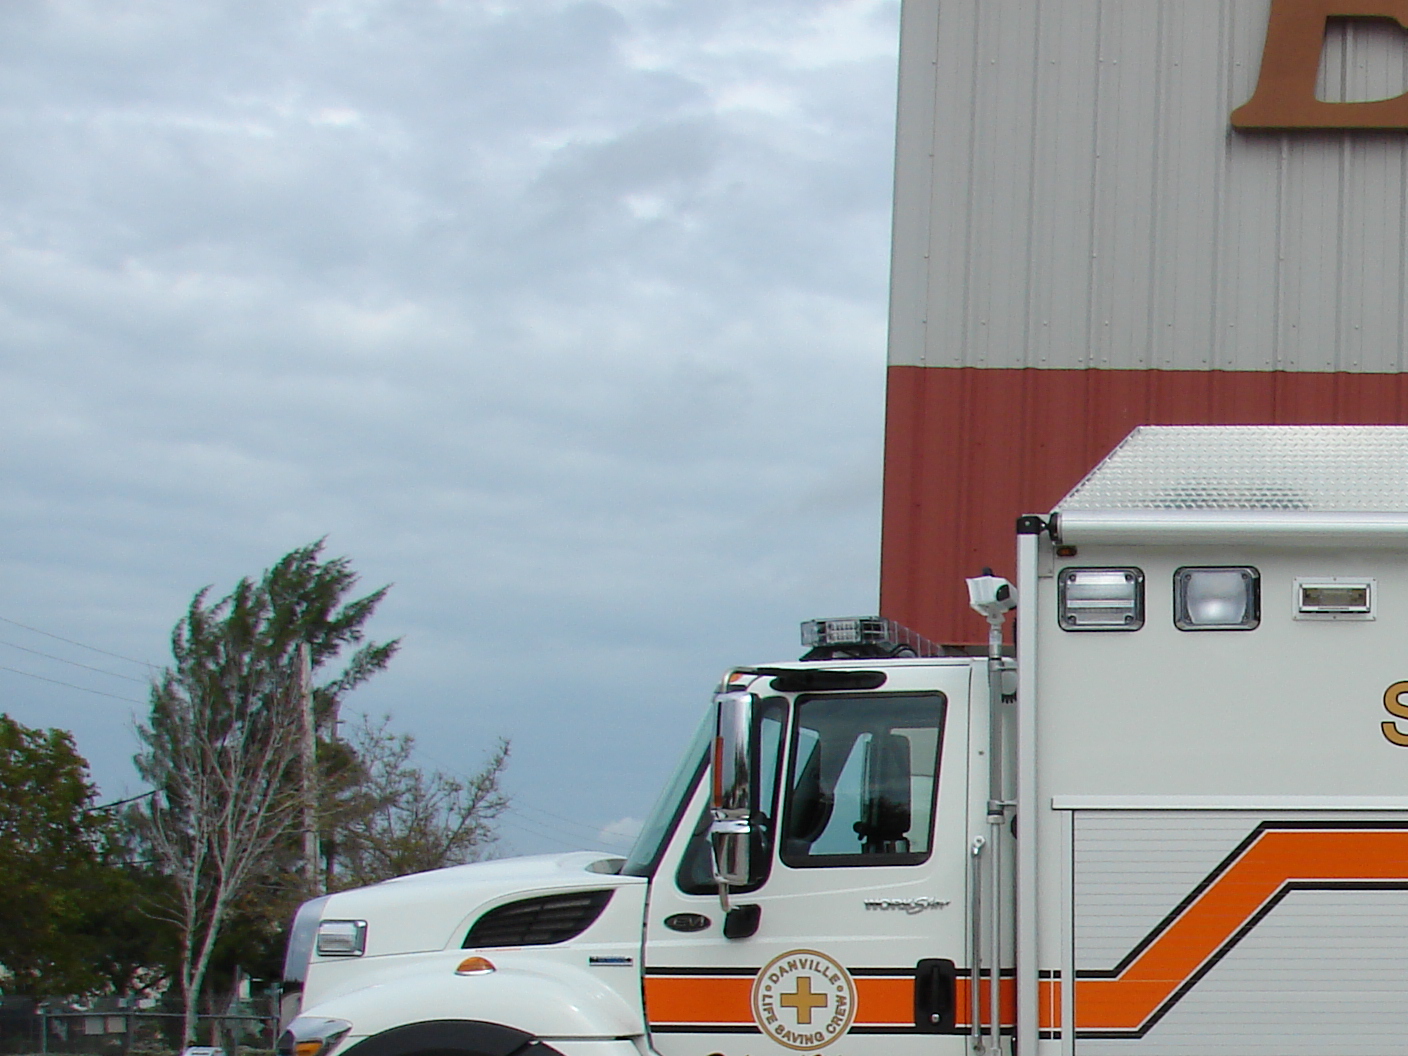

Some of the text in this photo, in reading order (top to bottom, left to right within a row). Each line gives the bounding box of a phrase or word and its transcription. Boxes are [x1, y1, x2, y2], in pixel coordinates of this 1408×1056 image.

[768, 958, 841, 985] DANVILLE
[762, 994, 847, 1045] LIFE SAVING CREW
